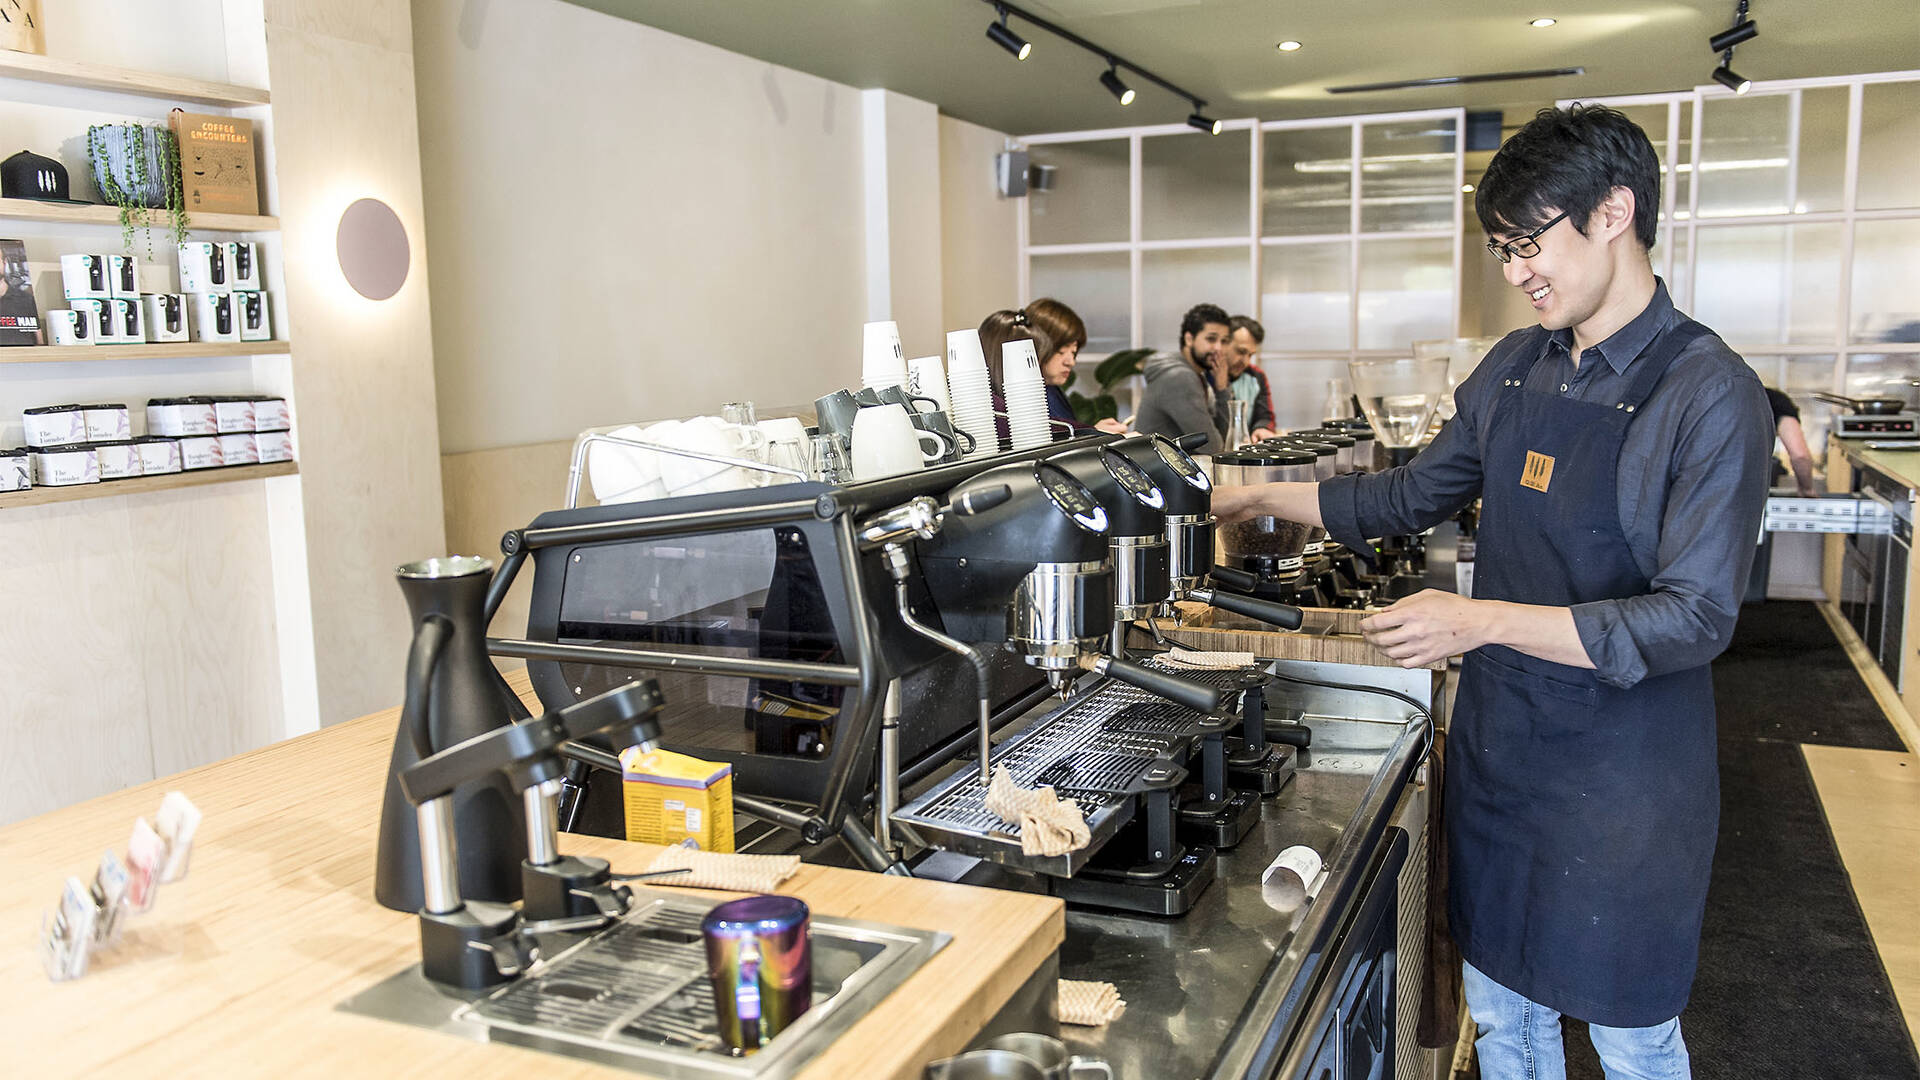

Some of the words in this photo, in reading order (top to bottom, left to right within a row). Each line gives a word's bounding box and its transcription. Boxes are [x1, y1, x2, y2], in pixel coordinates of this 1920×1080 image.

[202, 122, 235, 133] COFFEE
[190, 130, 248, 143] ENCOUNTERS
[0, 316, 16, 326] FEE
[17, 316, 38, 327] MAN
